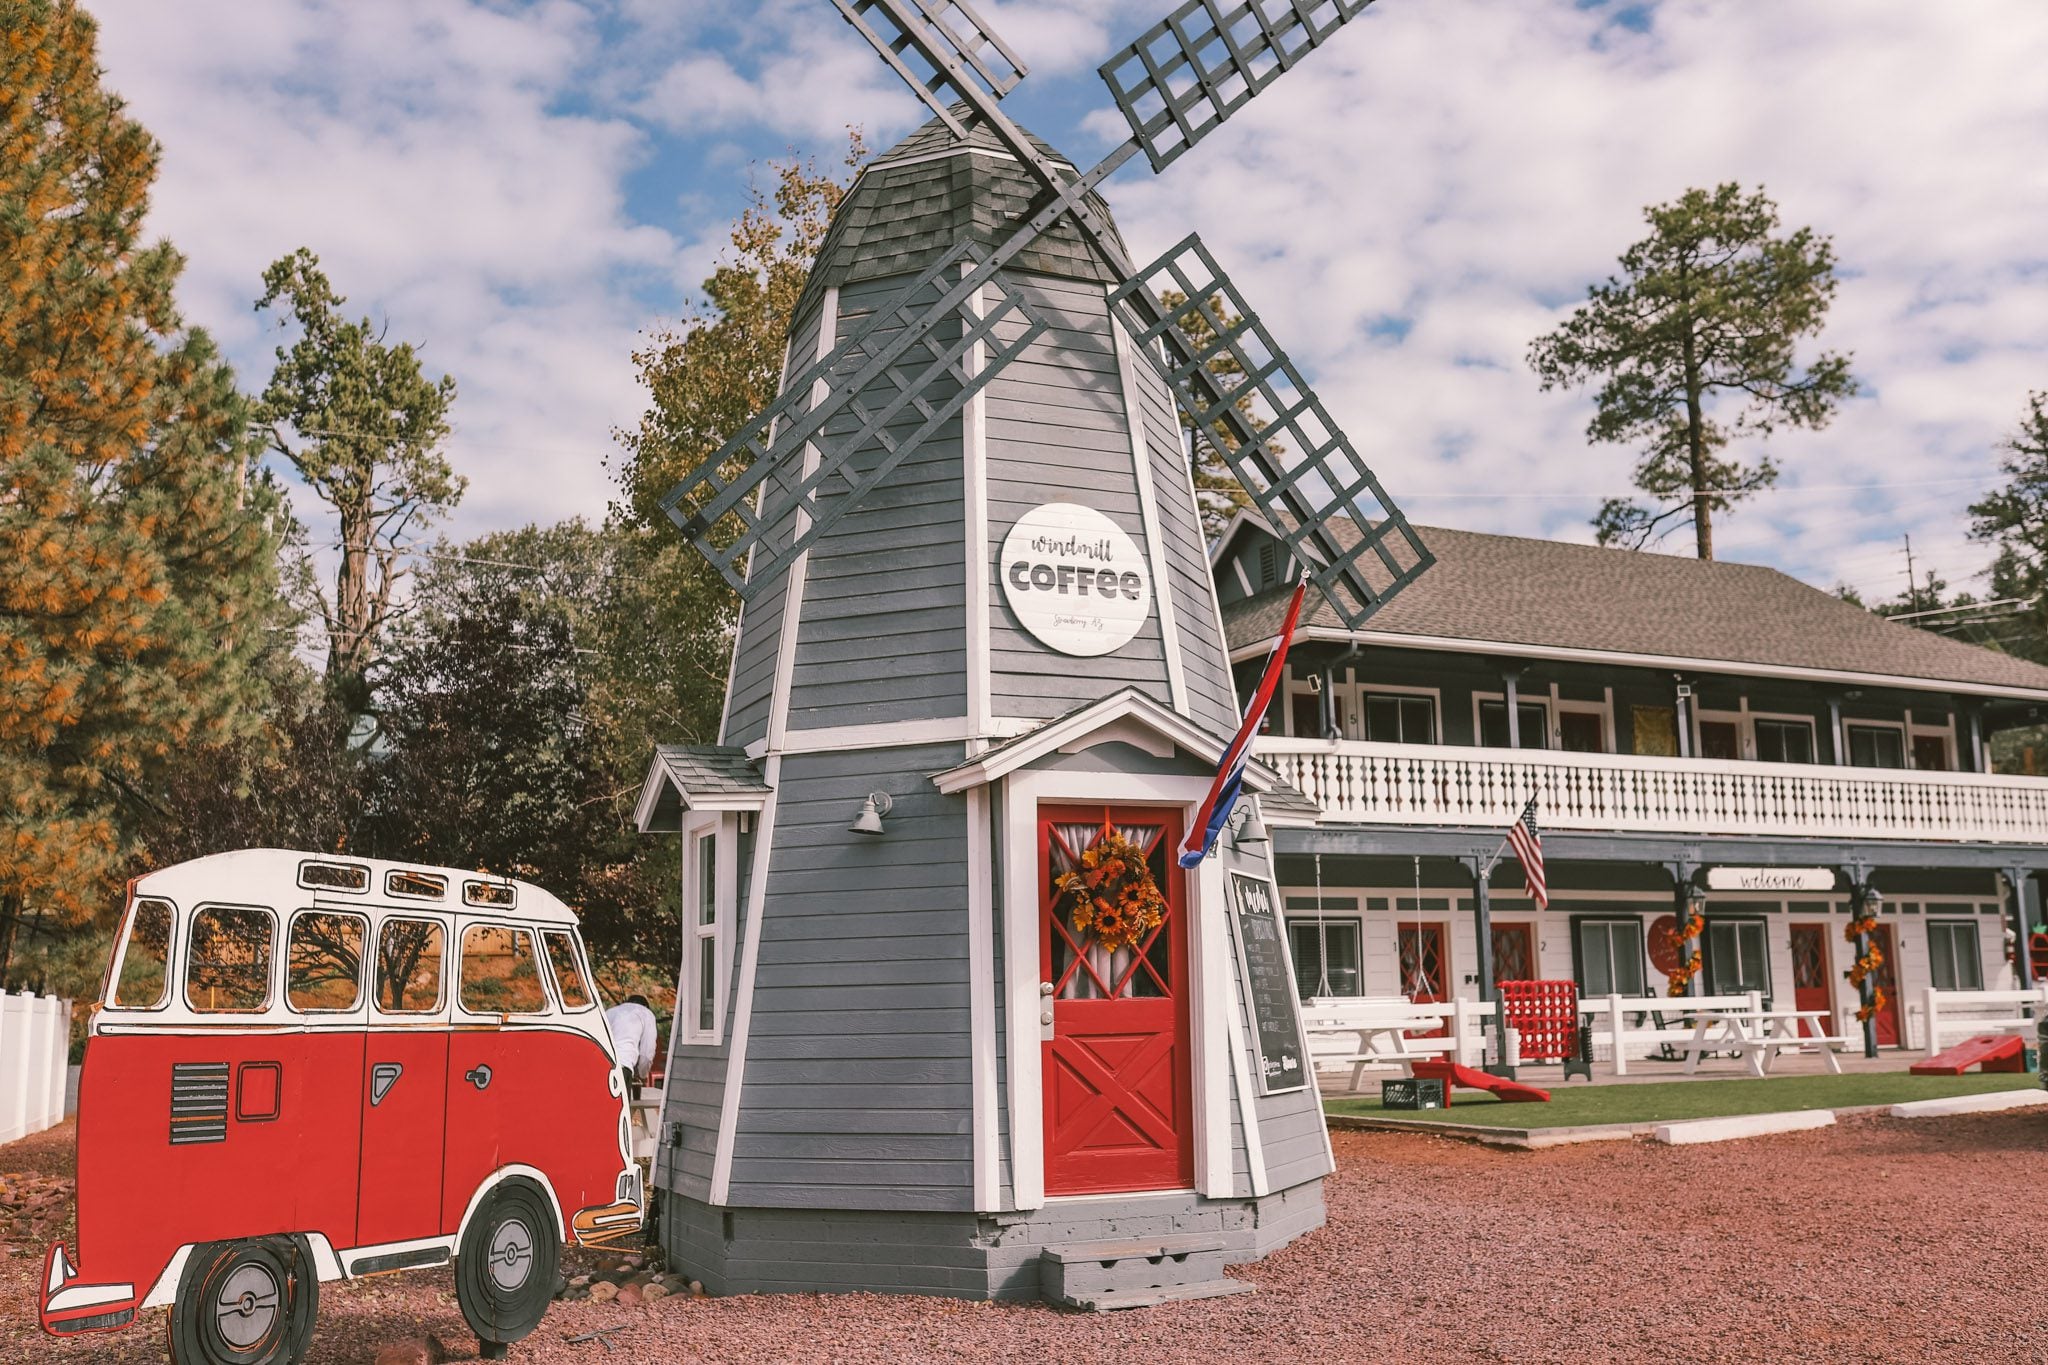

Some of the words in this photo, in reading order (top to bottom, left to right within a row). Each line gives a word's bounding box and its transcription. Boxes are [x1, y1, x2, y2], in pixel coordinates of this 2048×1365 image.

[1031, 535, 1114, 562] windmill
[1350, 714, 1357, 725] 5
[1740, 868, 1804, 889] welcome
[1541, 941, 1547, 951] 2
